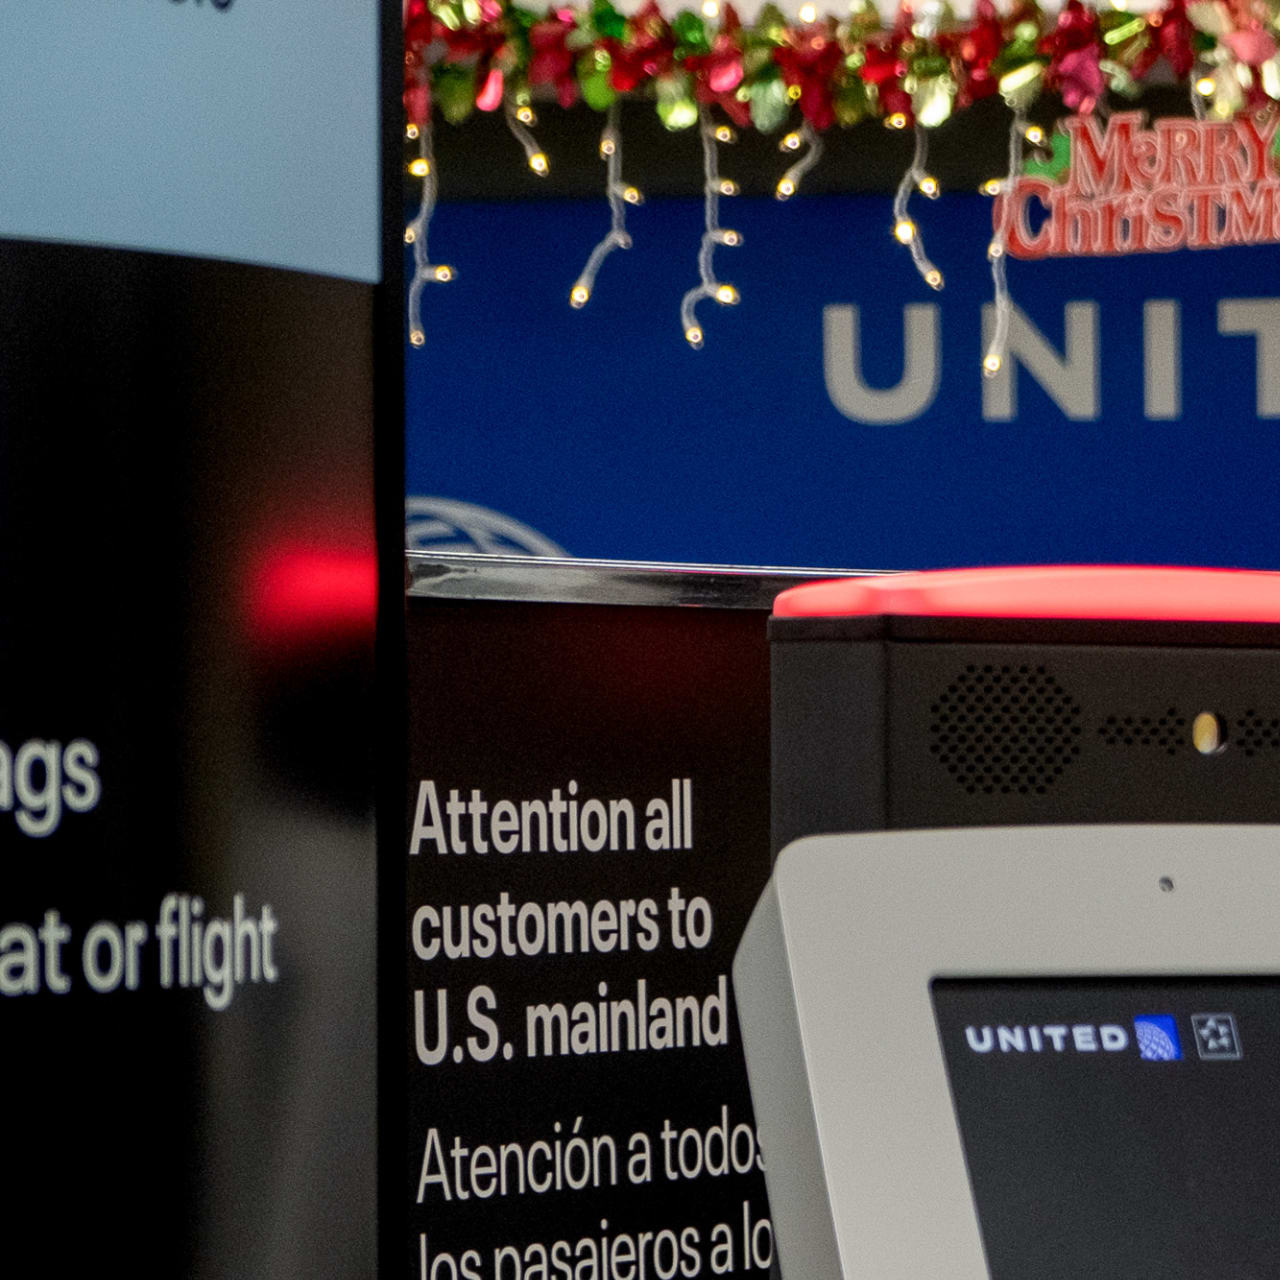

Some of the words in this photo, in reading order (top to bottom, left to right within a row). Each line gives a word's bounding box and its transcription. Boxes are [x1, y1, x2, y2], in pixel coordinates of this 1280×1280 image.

[409, 779, 636, 855] Attention
[644, 778, 693, 851] all
[82, 922, 148, 993] or
[155, 891, 281, 1012] flight
[411, 891, 660, 961] customers
[667, 886, 713, 950] to
[414, 984, 514, 1066] U.S.
[526, 974, 728, 1058] mainland
[965, 1024, 1128, 1053] UNITED
[416, 1115, 617, 1204] Atención
[627, 1132, 652, 1185] a
[710, 1223, 734, 1275] a
